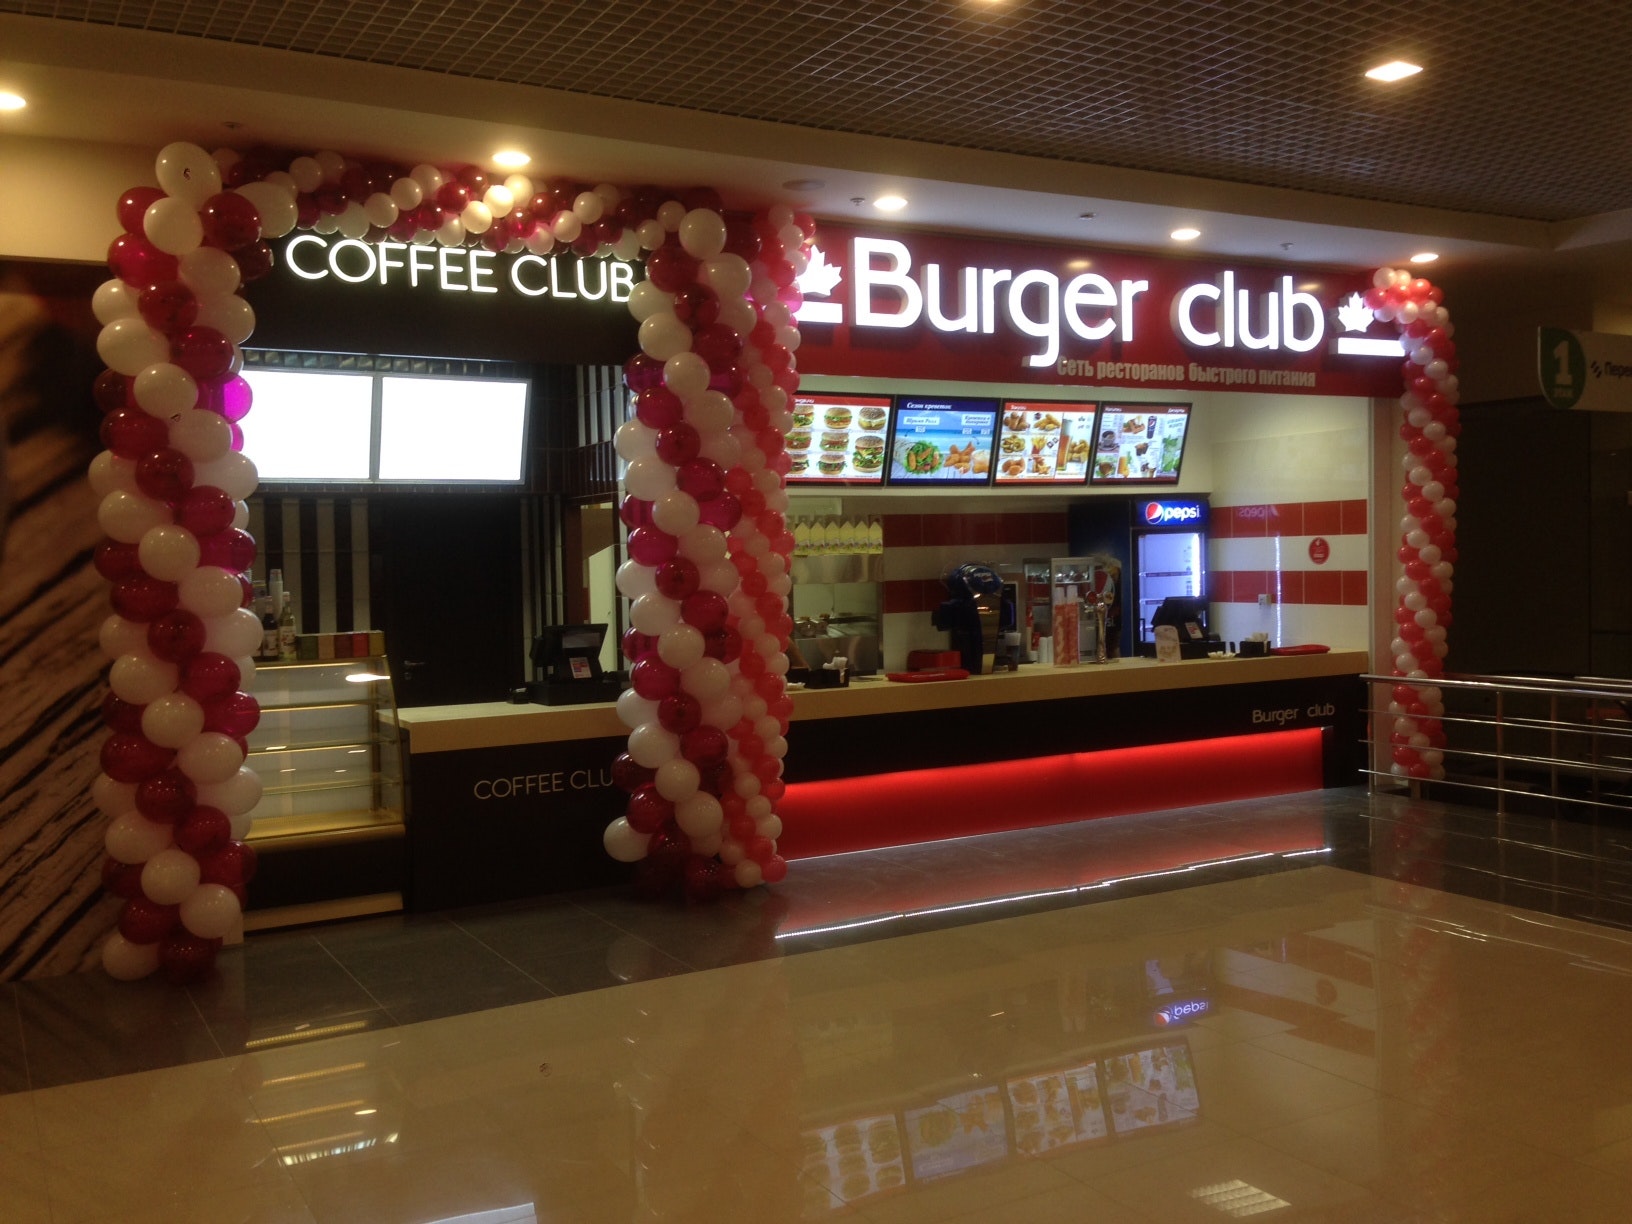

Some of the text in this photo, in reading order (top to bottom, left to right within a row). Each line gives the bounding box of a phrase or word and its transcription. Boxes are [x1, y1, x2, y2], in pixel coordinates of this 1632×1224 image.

[285, 233, 636, 303] COFFEE CLUB
[852, 235, 1326, 368] Burger club
[1057, 356, 1317, 388] Сеть ресторанов быстрого питания
[1553, 339, 1575, 386] 1
[1163, 504, 1201, 523] pepsi
[1252, 702, 1335, 726] Burger club
[473, 768, 614, 800] COFFEE CLU
